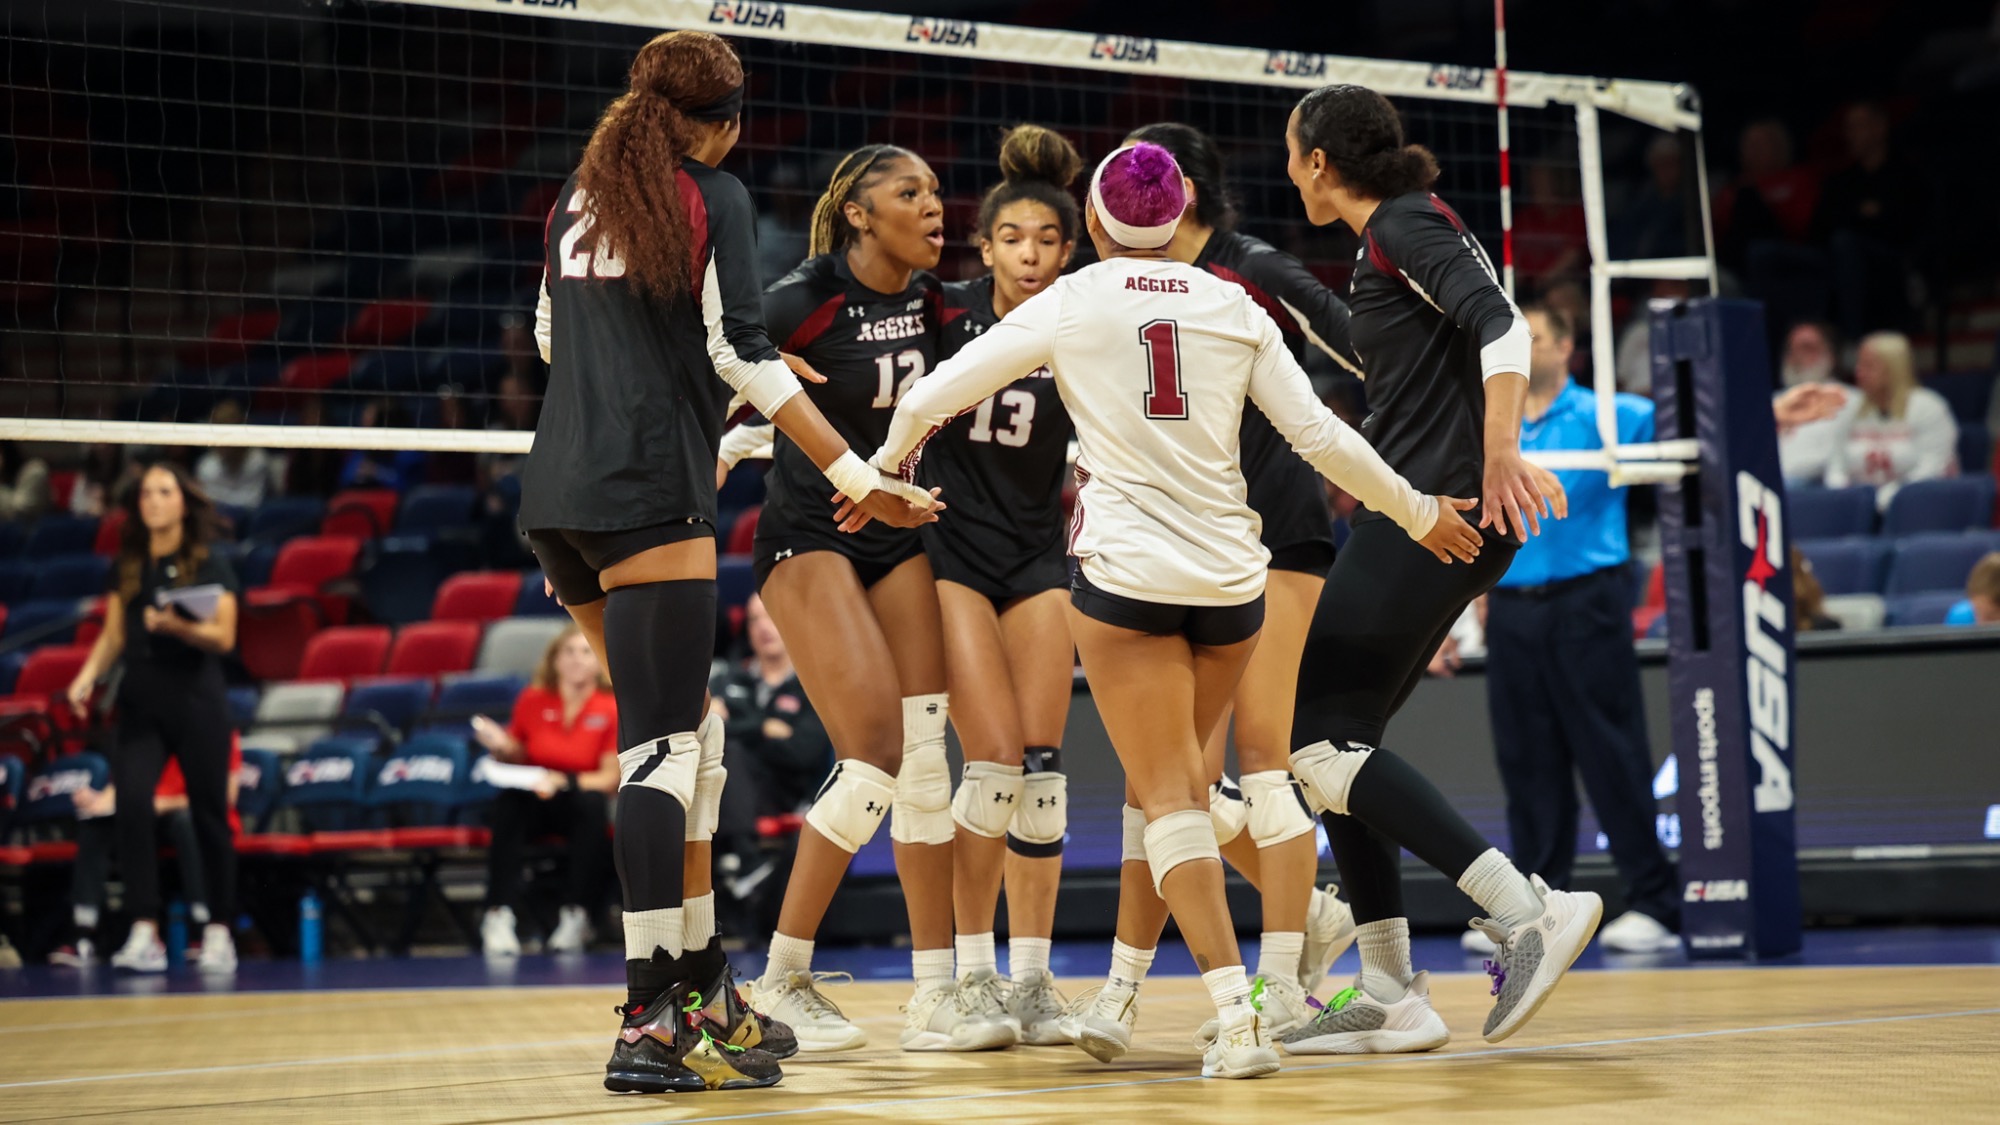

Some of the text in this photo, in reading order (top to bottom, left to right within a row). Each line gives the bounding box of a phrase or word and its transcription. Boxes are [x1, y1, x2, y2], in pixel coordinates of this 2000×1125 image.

[1125, 276, 1189, 294] AGGIES
[856, 313, 926, 342] AGGIES
[871, 350, 926, 409] 12
[1138, 318, 1189, 421] 1
[968, 389, 1036, 448] 13
